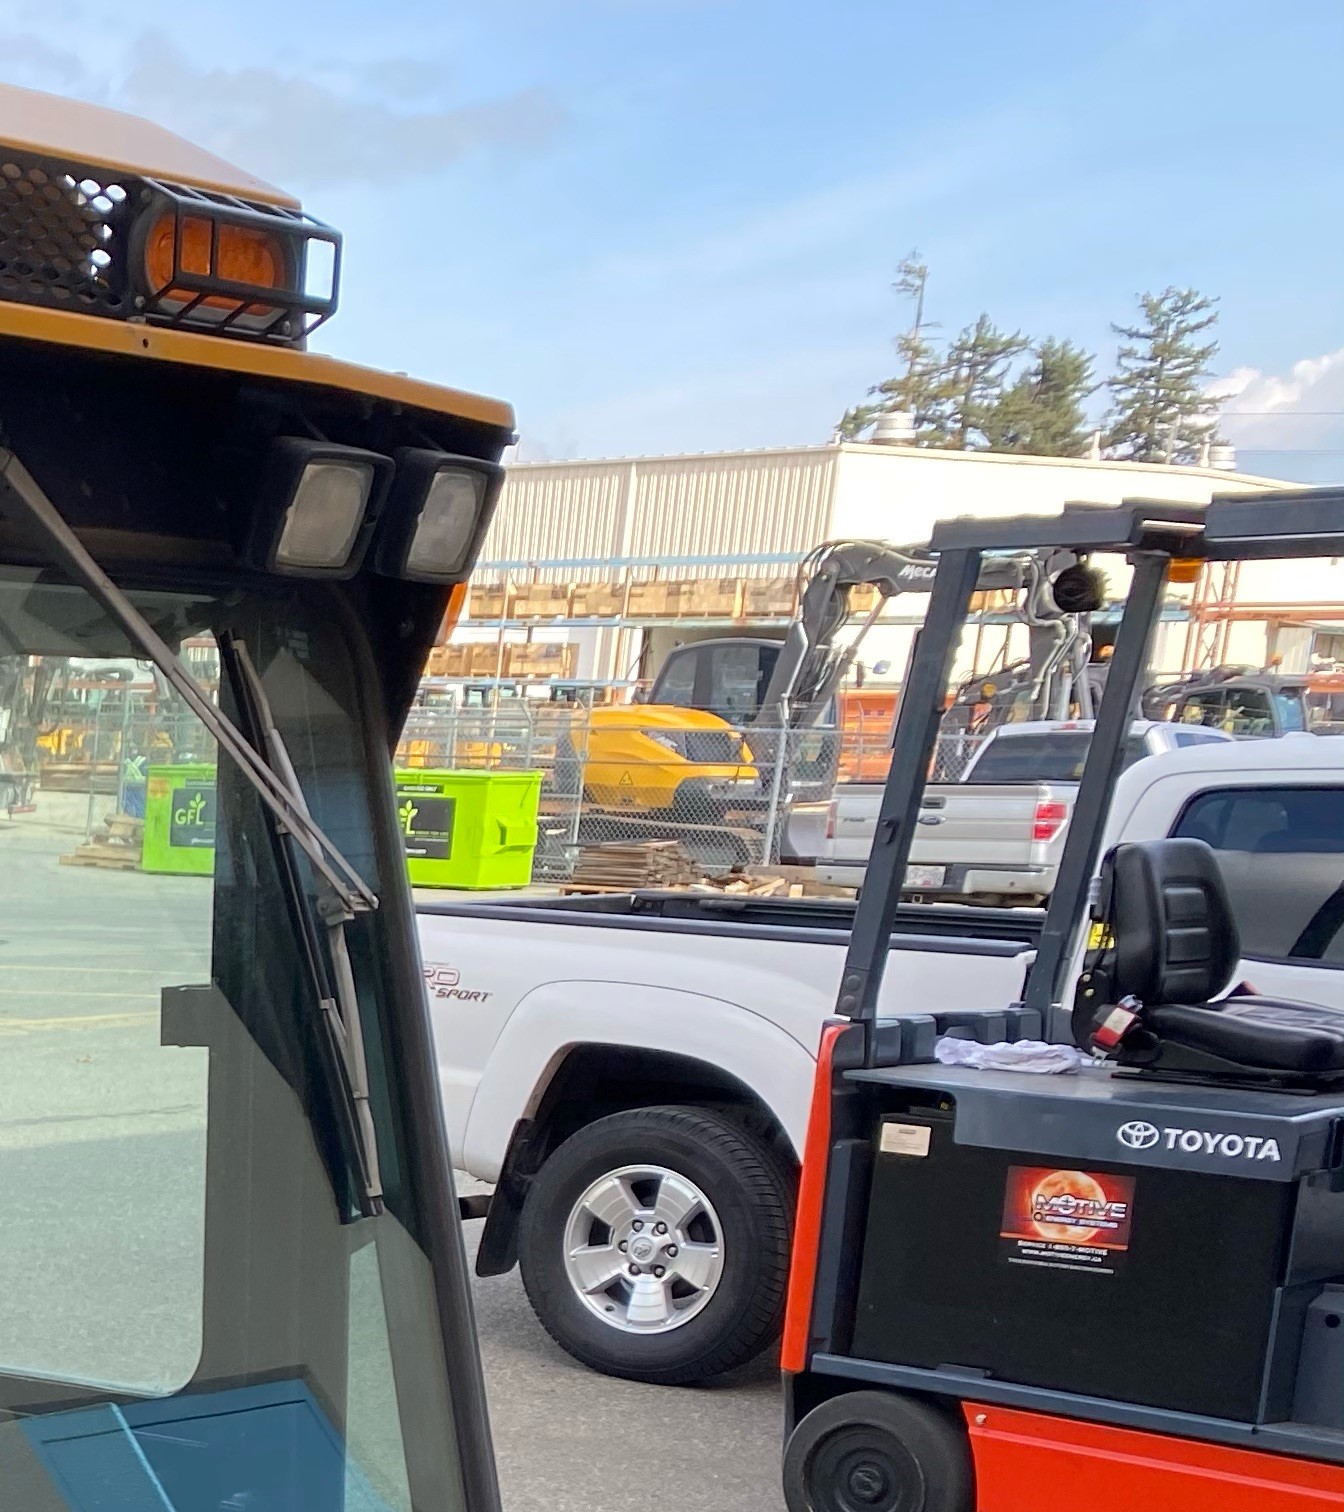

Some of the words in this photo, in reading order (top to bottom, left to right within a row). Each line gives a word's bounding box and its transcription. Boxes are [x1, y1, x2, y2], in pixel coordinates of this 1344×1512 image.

[435, 987, 493, 1002] SPORT
[1164, 1127, 1281, 1161] TOYOTA
[1035, 1193, 1128, 1218] MOTIVE
